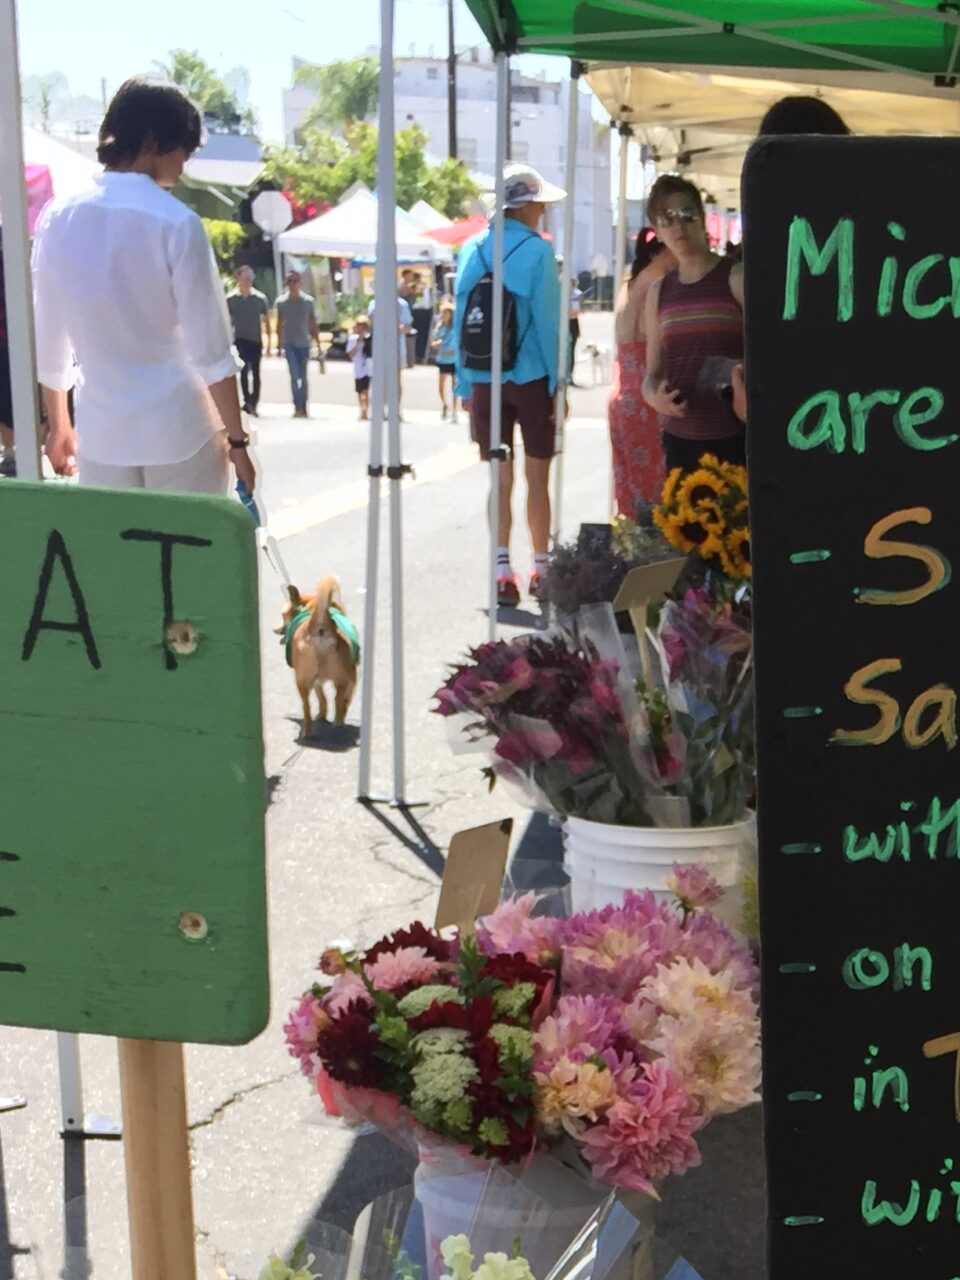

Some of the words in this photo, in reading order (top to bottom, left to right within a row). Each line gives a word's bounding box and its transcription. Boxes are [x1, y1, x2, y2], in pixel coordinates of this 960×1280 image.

[787, 387, 959, 454] are
[843, 943, 932, 991] on
[854, 1045, 909, 1112] in
